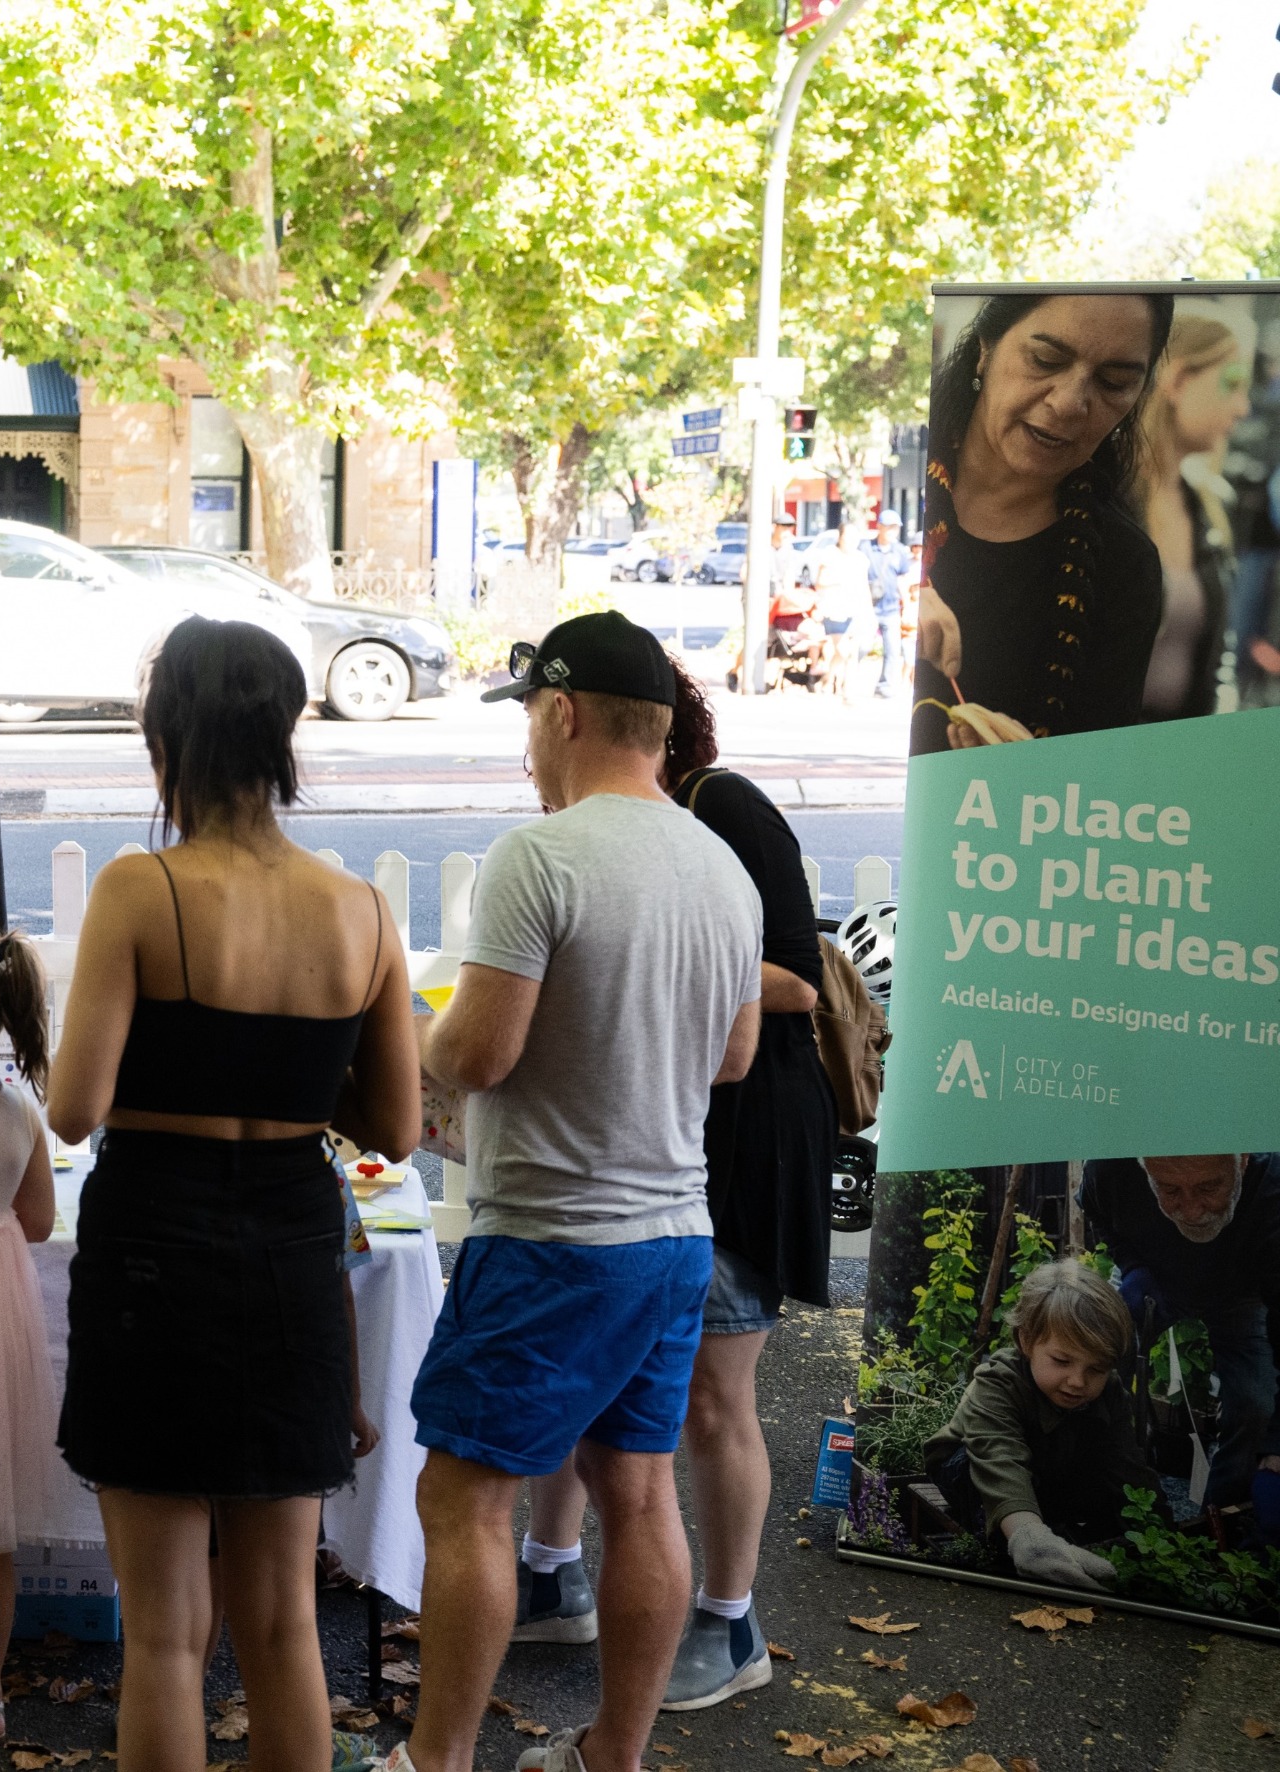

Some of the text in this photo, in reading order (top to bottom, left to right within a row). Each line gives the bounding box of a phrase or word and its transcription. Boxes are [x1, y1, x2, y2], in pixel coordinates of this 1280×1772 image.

[953, 778, 1192, 847] A place
[951, 840, 1213, 913] to plant
[944, 910, 1280, 985] your ideas
[941, 983, 1061, 1017] Adelaide.
[1071, 997, 1190, 1033] Designed
[1197, 1012, 1236, 1039] for
[1013, 1076, 1121, 1106] ADELAIDE
[1015, 1056, 1100, 1082] CITY OF
[80, 1579, 98, 1591] A4
